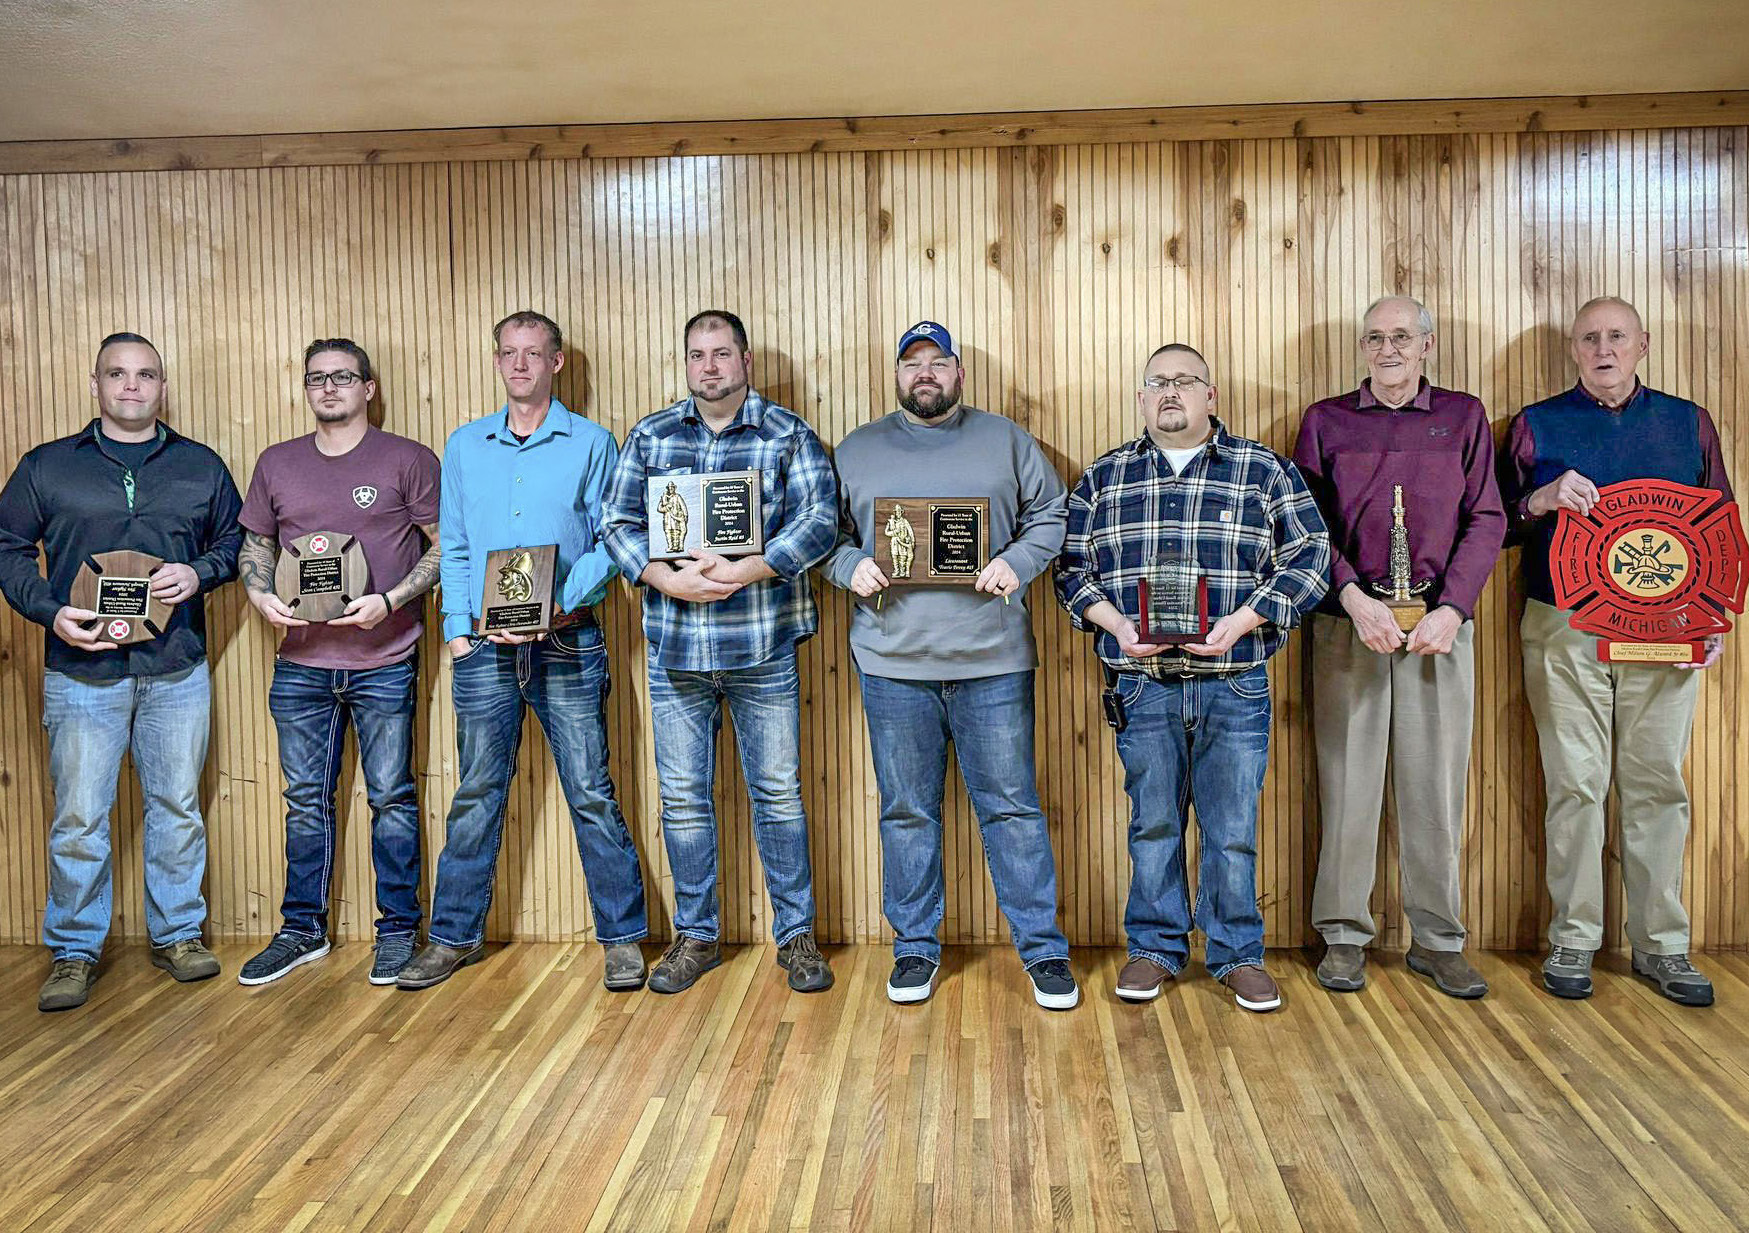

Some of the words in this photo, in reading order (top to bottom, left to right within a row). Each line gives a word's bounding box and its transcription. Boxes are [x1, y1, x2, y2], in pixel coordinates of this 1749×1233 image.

[1606, 493, 1684, 512] GLADWIN
[1570, 532, 1582, 584] FIRE
[1716, 530, 1729, 585] DEPT
